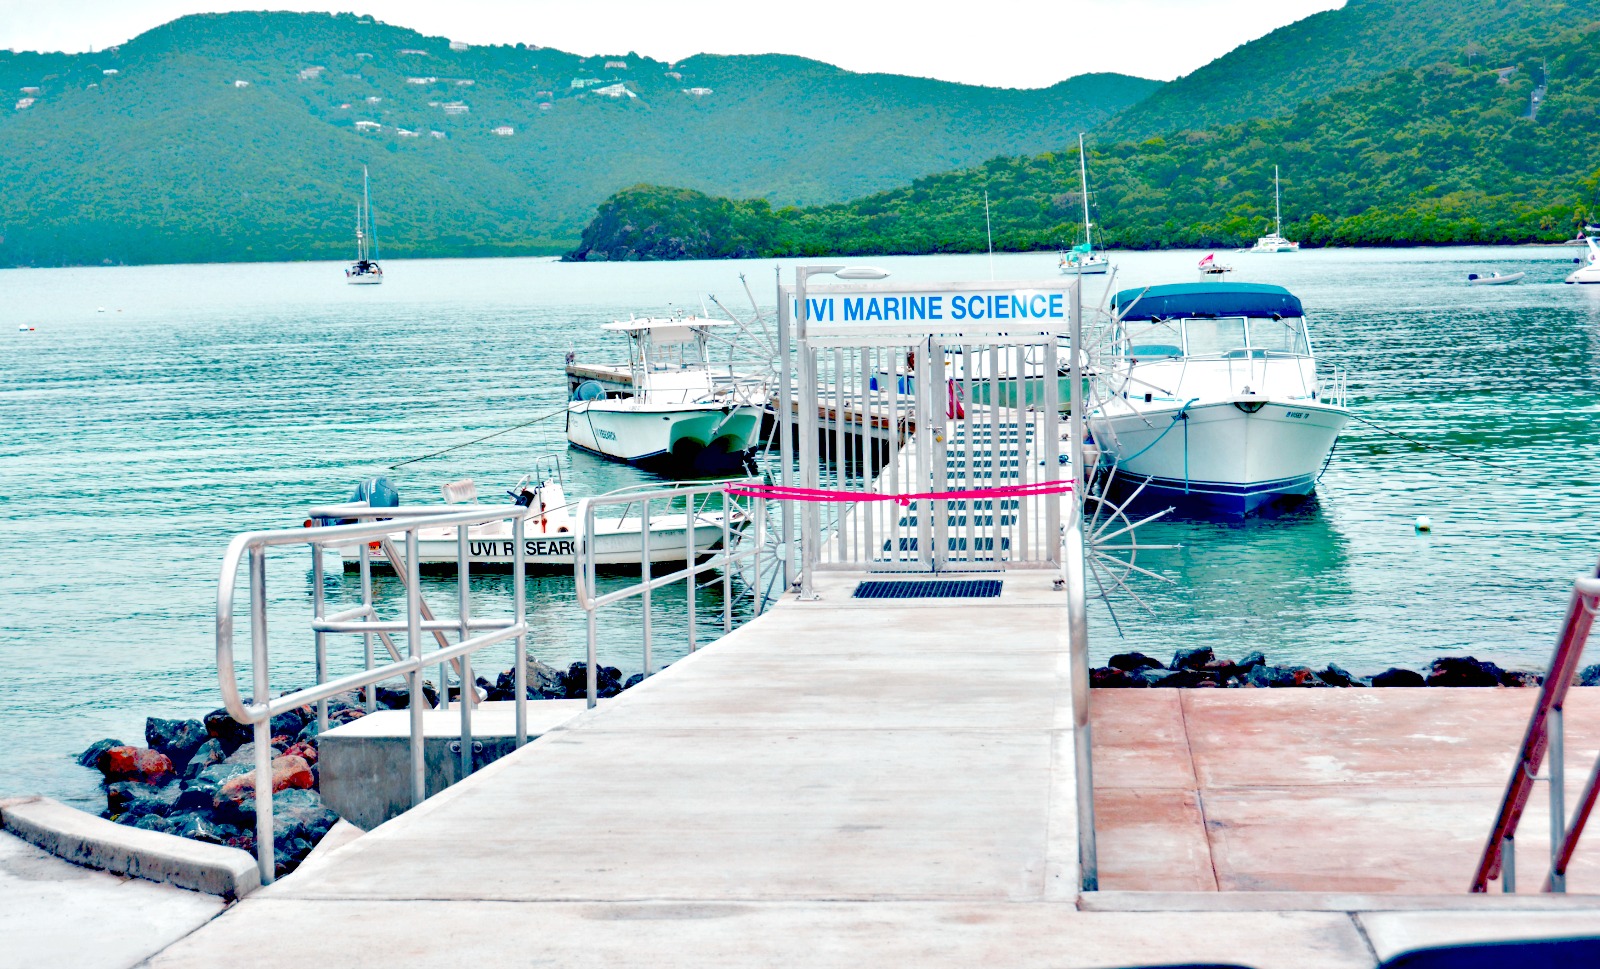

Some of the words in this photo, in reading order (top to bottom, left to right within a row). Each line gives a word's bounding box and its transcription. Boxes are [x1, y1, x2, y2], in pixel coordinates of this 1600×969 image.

[794, 298, 834, 321] UVI
[843, 296, 943, 321] MARINE
[951, 294, 1064, 319] SCIENCE
[470, 541, 497, 556] UVI
